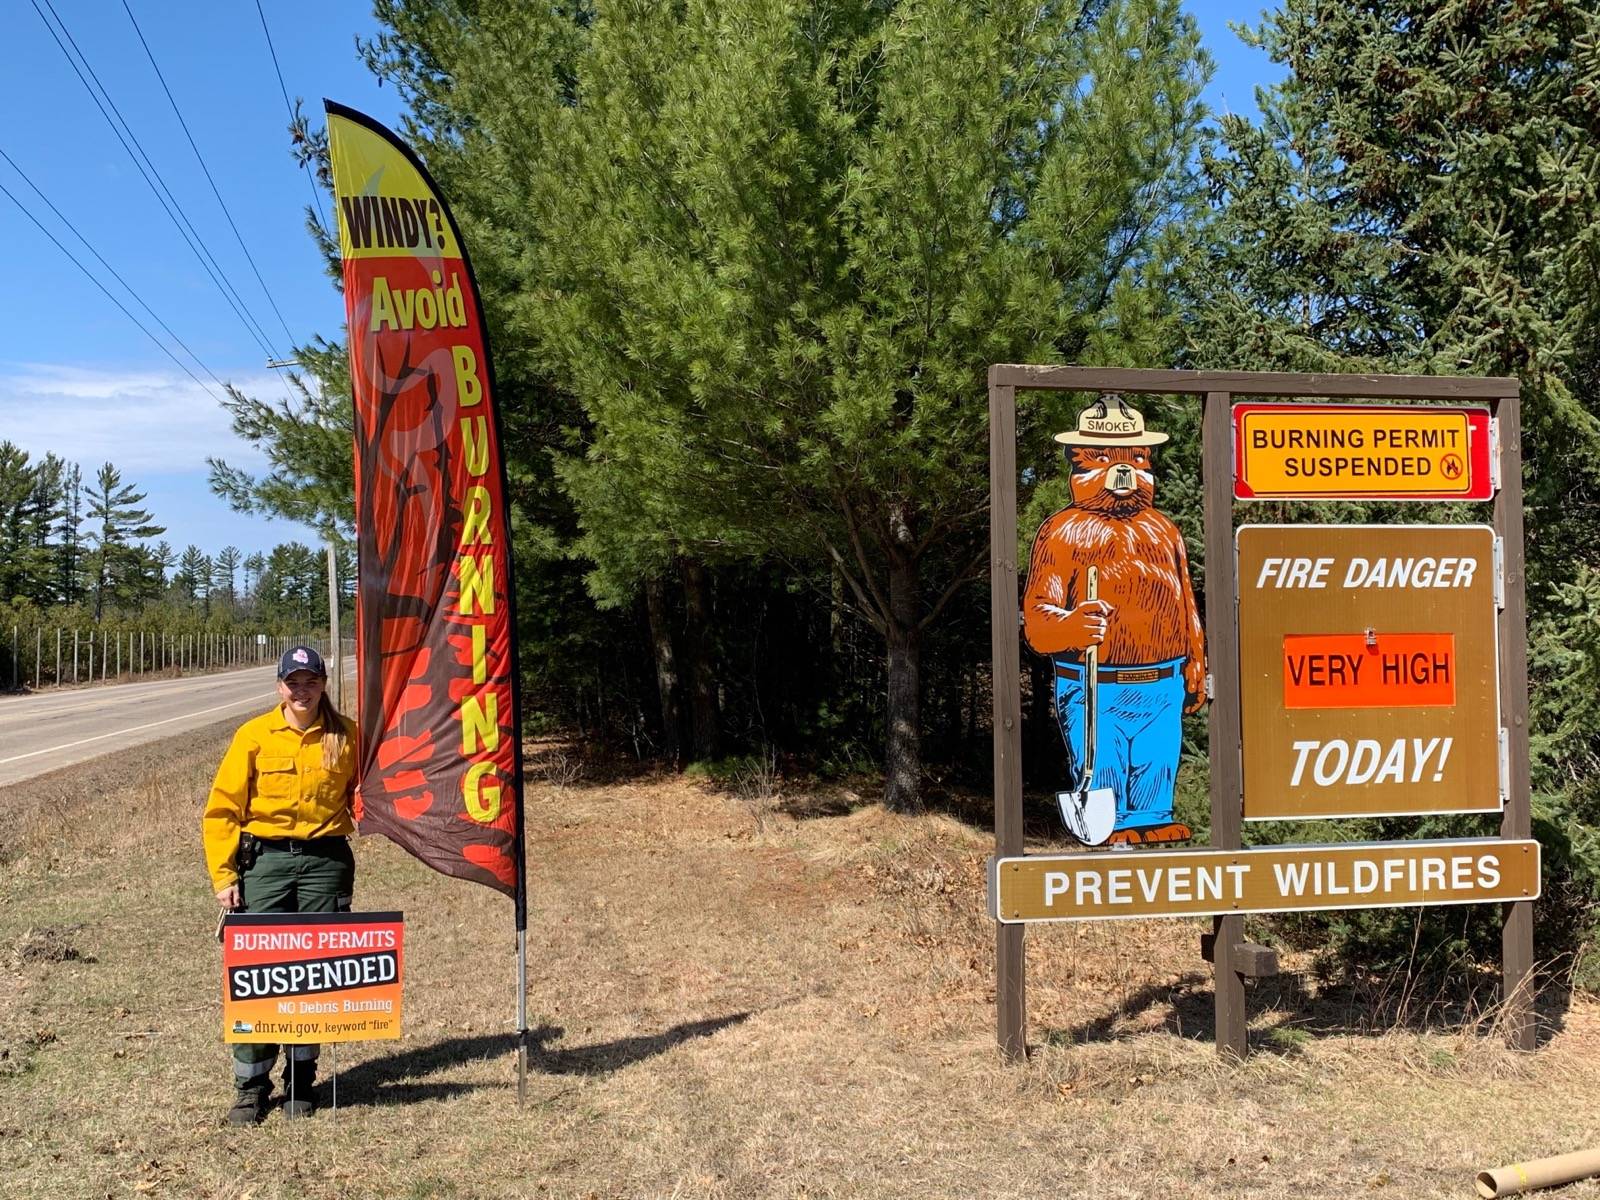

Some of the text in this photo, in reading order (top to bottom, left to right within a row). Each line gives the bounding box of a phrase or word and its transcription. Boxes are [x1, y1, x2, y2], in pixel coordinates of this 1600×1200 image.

[341, 196, 445, 250] WINDY?
[371, 270, 467, 332] Avoid
[1087, 420, 1137, 431] SMOKEY
[1253, 429, 1459, 449] BURNING PERMIT
[1285, 457, 1431, 476] SUSPENDED
[452, 345, 500, 823] BURNING
[1256, 557, 1477, 589] FIRE DANGER
[1288, 653, 1449, 686] VERY HIGH
[1290, 737, 1453, 786] TODAY!
[1044, 855, 1501, 906] PREVENT WILDFIRES
[233, 930, 395, 950] BURNING PERMITS
[233, 954, 396, 997] SUSPENDED
[278, 999, 393, 1014] NO Debris Burning
[325, 1020, 367, 1035] keyword
